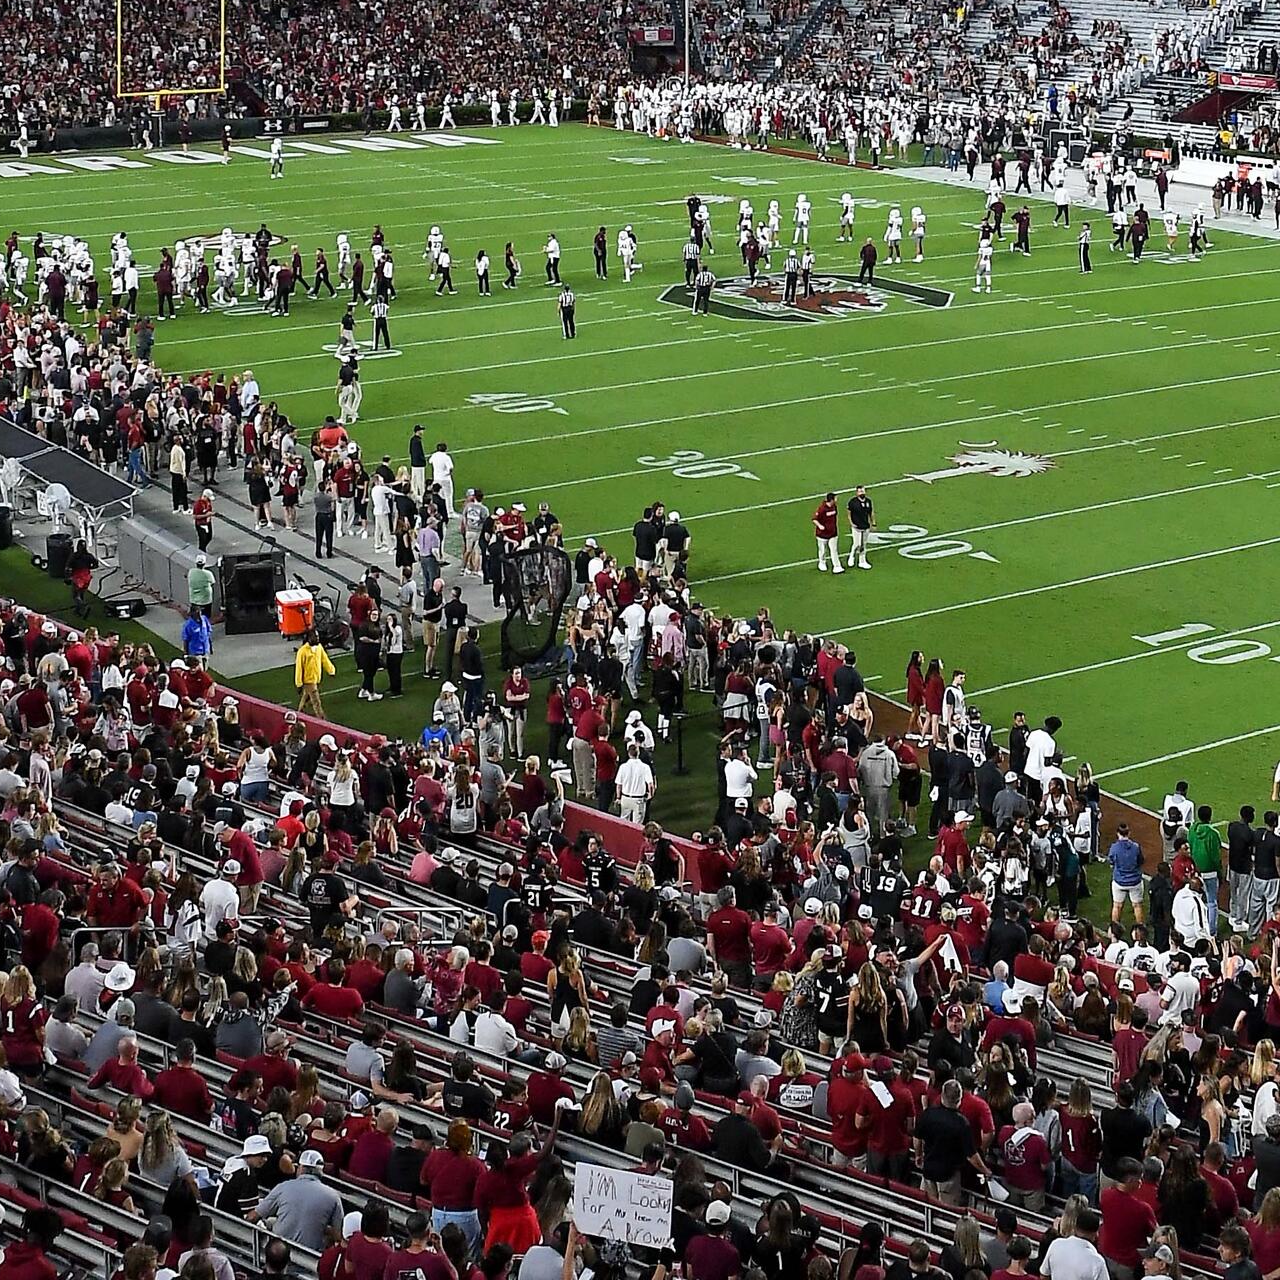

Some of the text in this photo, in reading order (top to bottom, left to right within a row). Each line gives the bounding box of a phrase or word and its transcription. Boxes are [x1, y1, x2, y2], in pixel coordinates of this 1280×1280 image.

[637, 450, 742, 479] 30
[860, 524, 973, 560] 20
[1131, 622, 1272, 665] 10
[591, 871, 600, 888] 5
[877, 876, 897, 892] 19
[527, 891, 540, 907] 21
[911, 896, 933, 919] 11
[819, 991, 831, 1013] 7
[6, 1010, 15, 1033] 1
[493, 1111, 511, 1130] 22
[1066, 1128, 1076, 1152] 1
[79, 1172, 92, 1193] 1
[582, 1196, 606, 1214] For
[598, 1218, 616, 1241] A
[776, 1251, 783, 1270] 1
